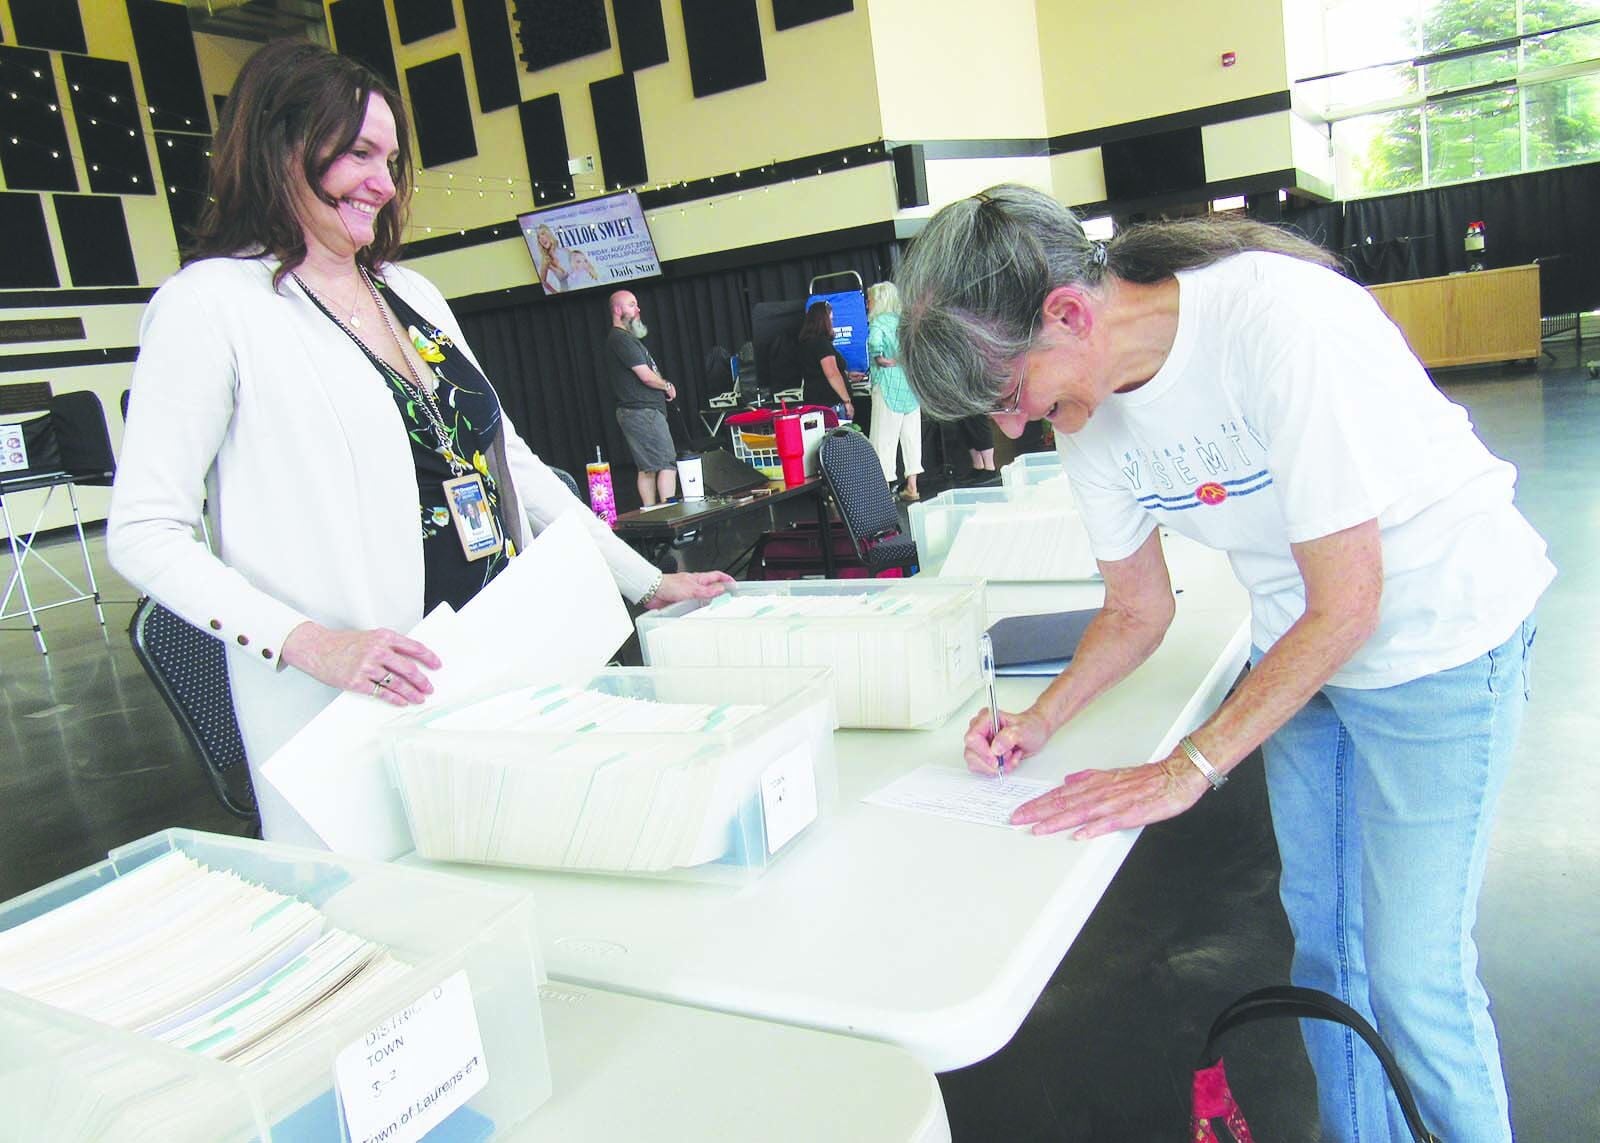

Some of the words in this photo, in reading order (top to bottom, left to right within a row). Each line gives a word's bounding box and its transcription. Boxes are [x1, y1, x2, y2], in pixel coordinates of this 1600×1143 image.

[556, 225, 598, 249] TAYLOR
[598, 216, 634, 240] SWIFT
[610, 265, 633, 279] Daily
[635, 263, 655, 273] Star
[367, 1036, 405, 1068] TOWN
[362, 1122, 398, 1143] own
[401, 1106, 412, 1125] of
[416, 1070, 463, 1114] Laurens
